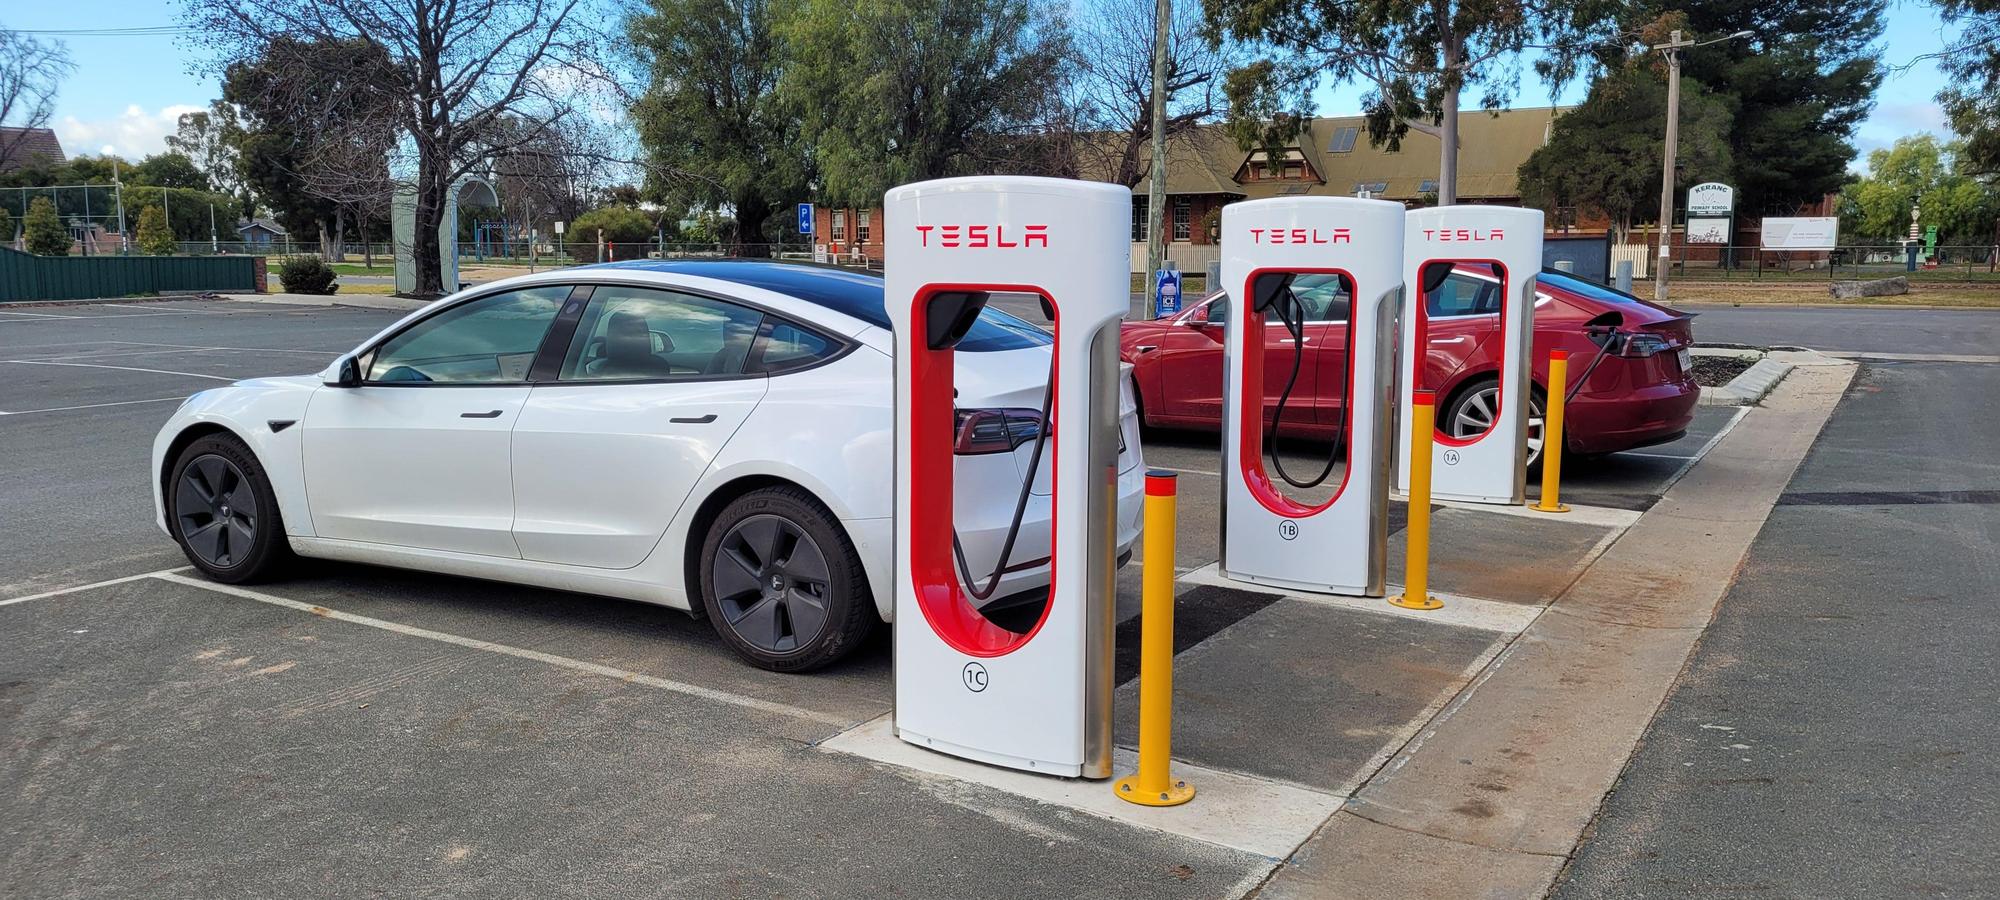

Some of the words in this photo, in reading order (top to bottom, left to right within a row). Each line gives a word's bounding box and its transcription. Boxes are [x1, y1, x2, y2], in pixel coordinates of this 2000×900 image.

[801, 208, 808, 218] P
[915, 225, 1048, 248] TESLA
[1249, 228, 1351, 244] TESLA
[1422, 229, 1504, 241] TESLA
[1162, 297, 1175, 305] ICE
